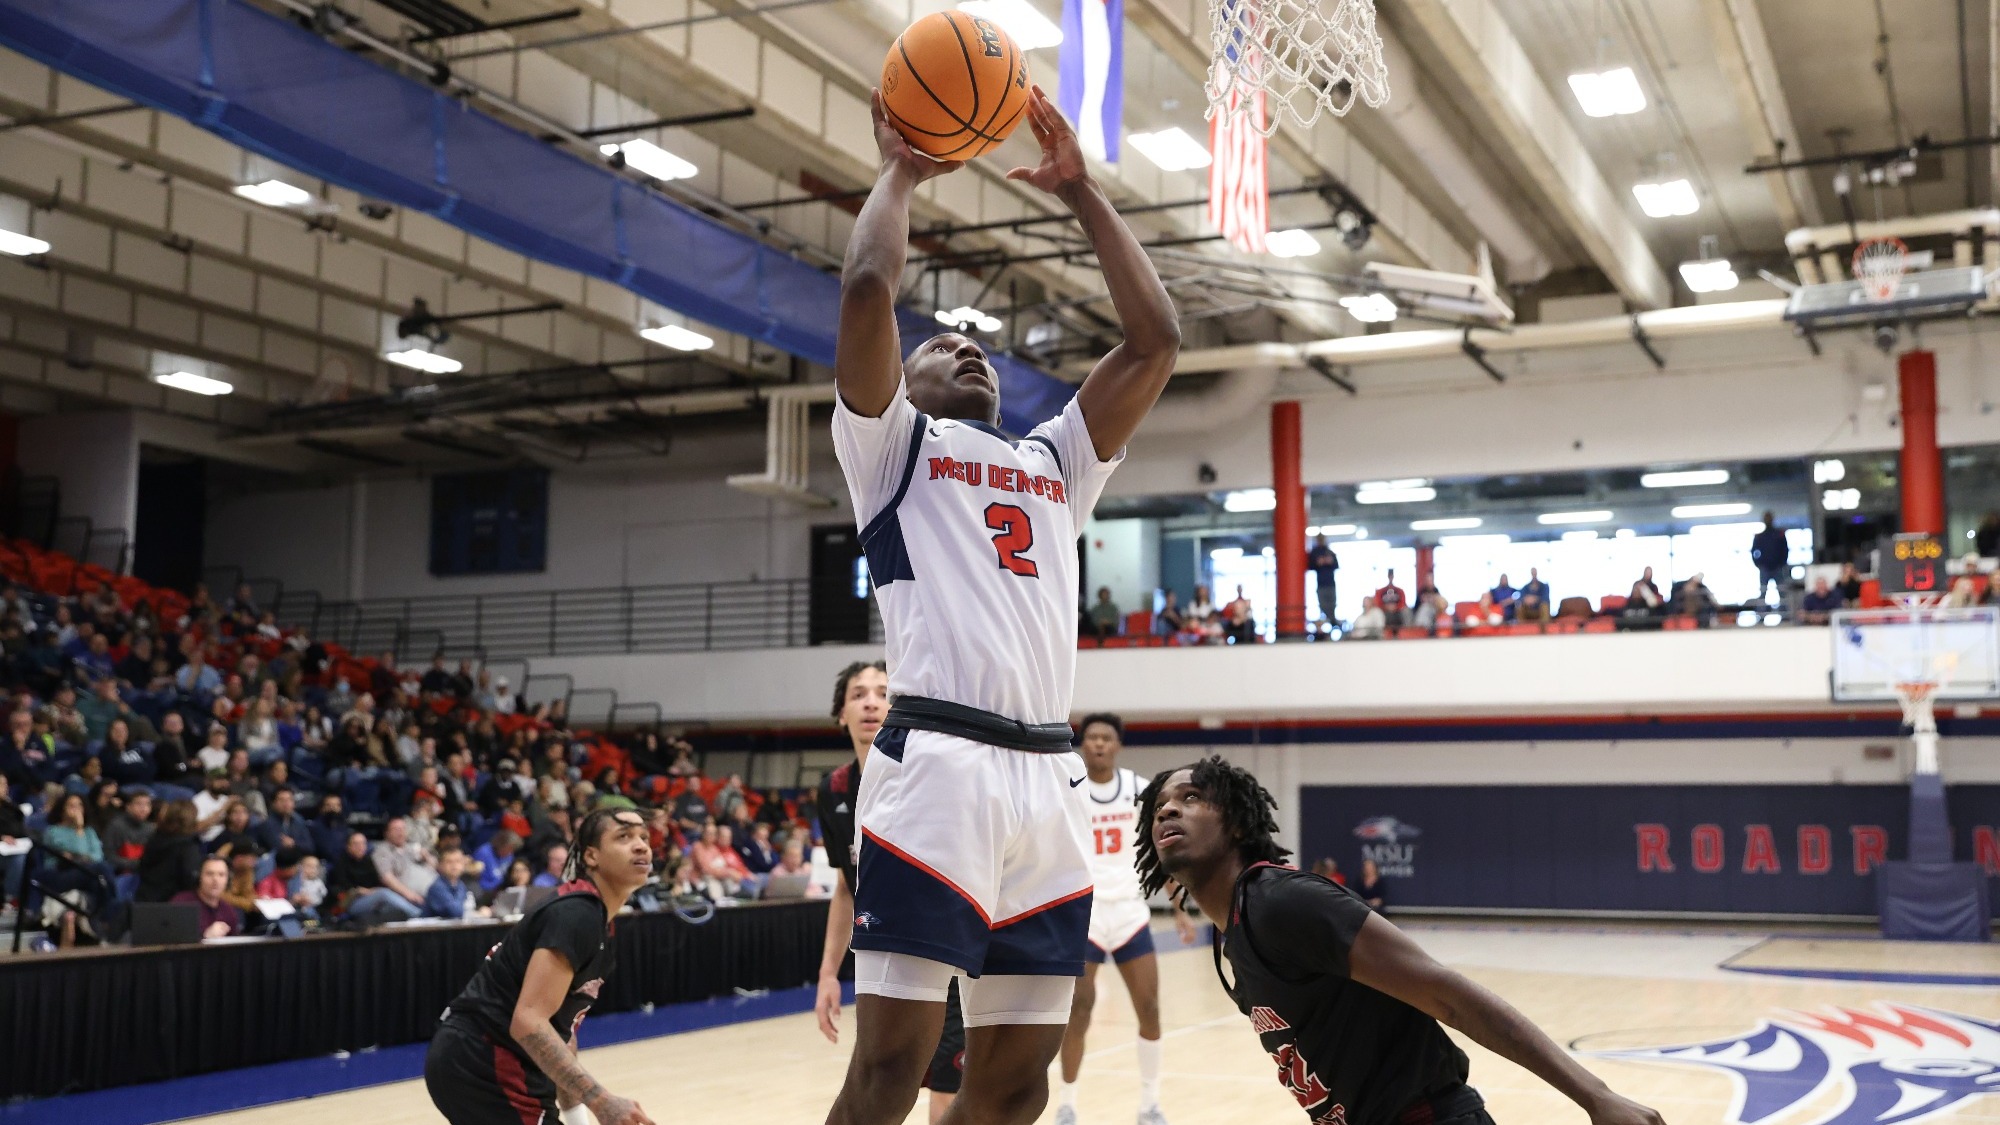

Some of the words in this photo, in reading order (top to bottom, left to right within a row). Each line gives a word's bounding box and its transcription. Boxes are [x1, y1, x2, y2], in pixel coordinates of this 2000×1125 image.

[928, 457, 981, 486] MSU
[988, 464, 1067, 504] DENVER
[984, 502, 1039, 579] 2
[1093, 828, 1122, 855] 13
[1634, 823, 2000, 877] ROADRN
